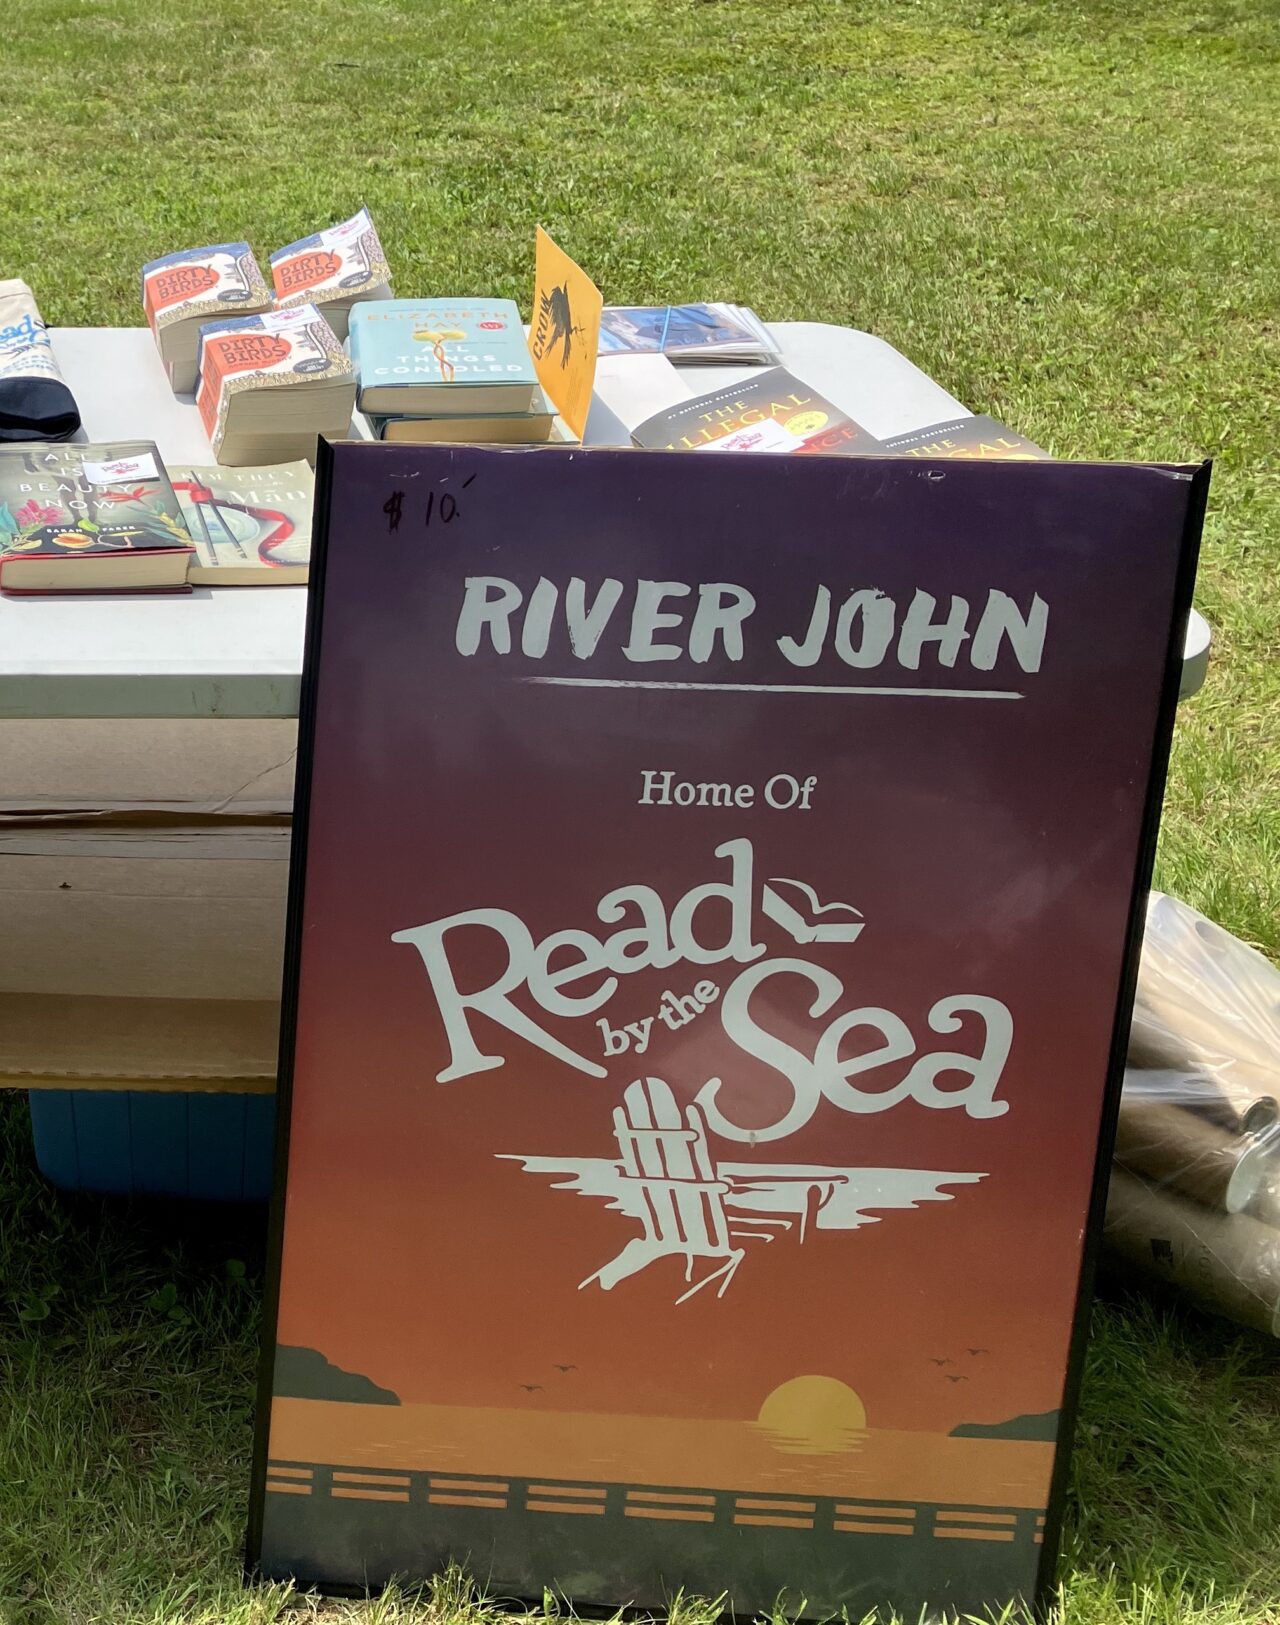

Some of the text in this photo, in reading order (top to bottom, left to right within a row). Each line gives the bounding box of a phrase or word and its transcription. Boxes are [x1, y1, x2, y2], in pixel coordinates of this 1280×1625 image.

[279, 249, 336, 278] DIRTY
[281, 261, 337, 288] BIRDS
[154, 264, 212, 289] DIRTY
[157, 275, 216, 299] BIRDS
[367, 312, 509, 321] ELIZABETH
[532, 288, 553, 361] CROW
[218, 333, 280, 352] DIRTY
[224, 345, 287, 364] BIRDS
[699, 400, 749, 423] THE
[44, 452, 89, 463] ALL
[905, 439, 957, 457] THE
[61, 467, 83, 476] IS
[20, 482, 135, 493] BEAUTY
[44, 499, 116, 510] NOW
[455, 576, 1050, 673] RIVER JOHN
[638, 770, 819, 811] Home Of
[391, 837, 767, 1083] Read
[596, 978, 721, 1058] by the
[695, 957, 1016, 1142] Sea
